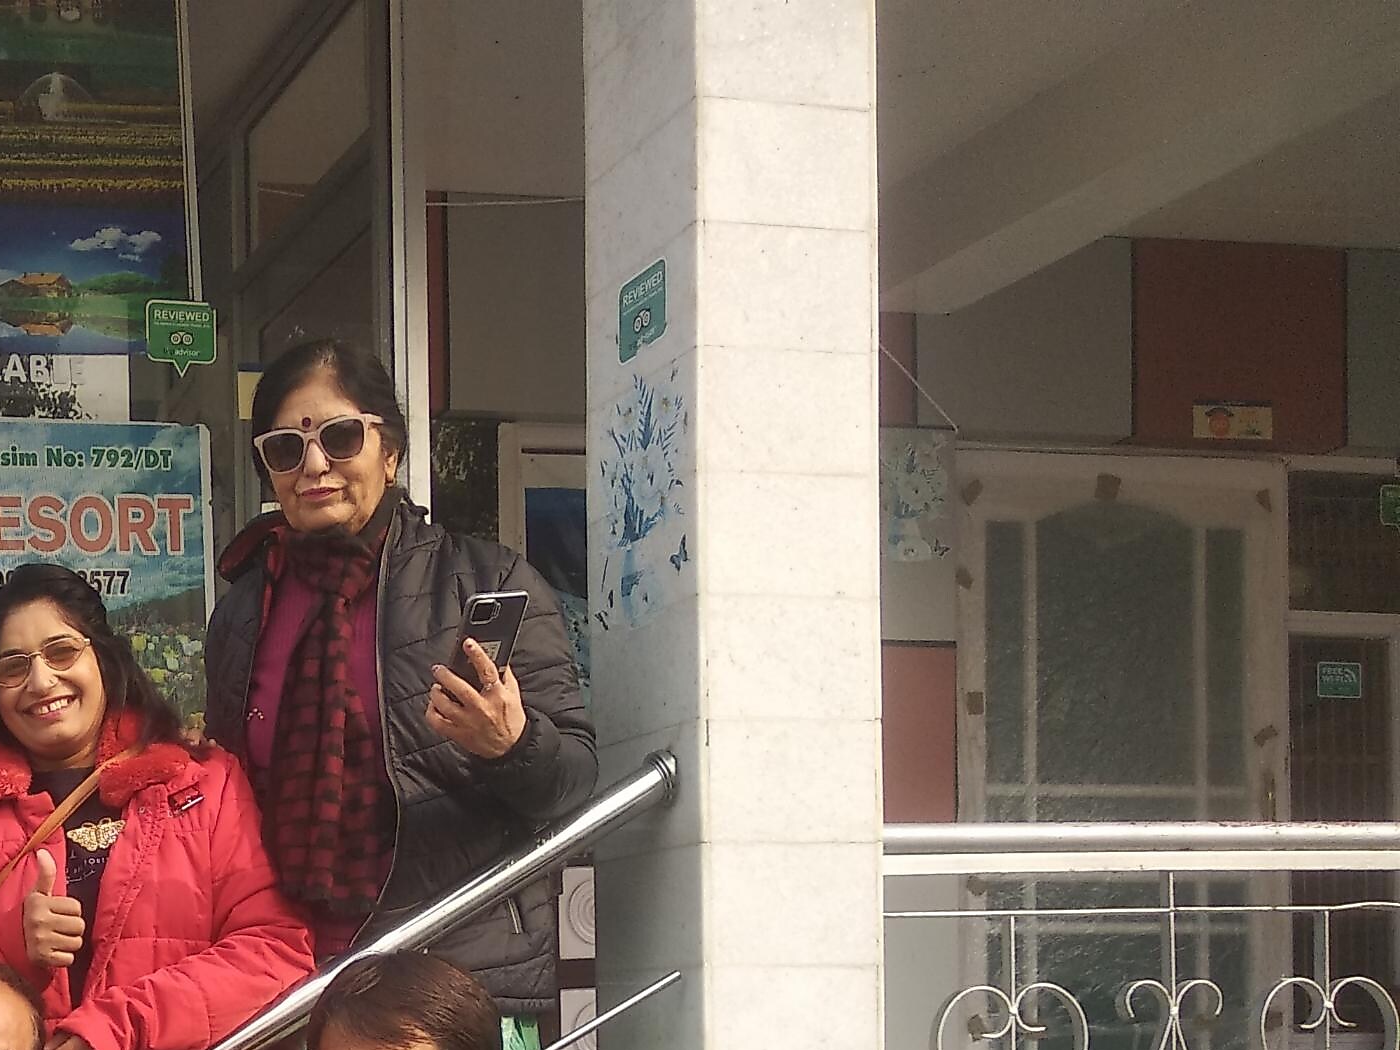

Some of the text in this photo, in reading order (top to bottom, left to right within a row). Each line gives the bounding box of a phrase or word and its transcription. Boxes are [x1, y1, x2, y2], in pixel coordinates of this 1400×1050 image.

[622, 271, 663, 307] REVIEWED
[154, 309, 210, 322] REVIEWED
[46, 447, 86, 469] No:
[91, 448, 173, 470] 792/DT
